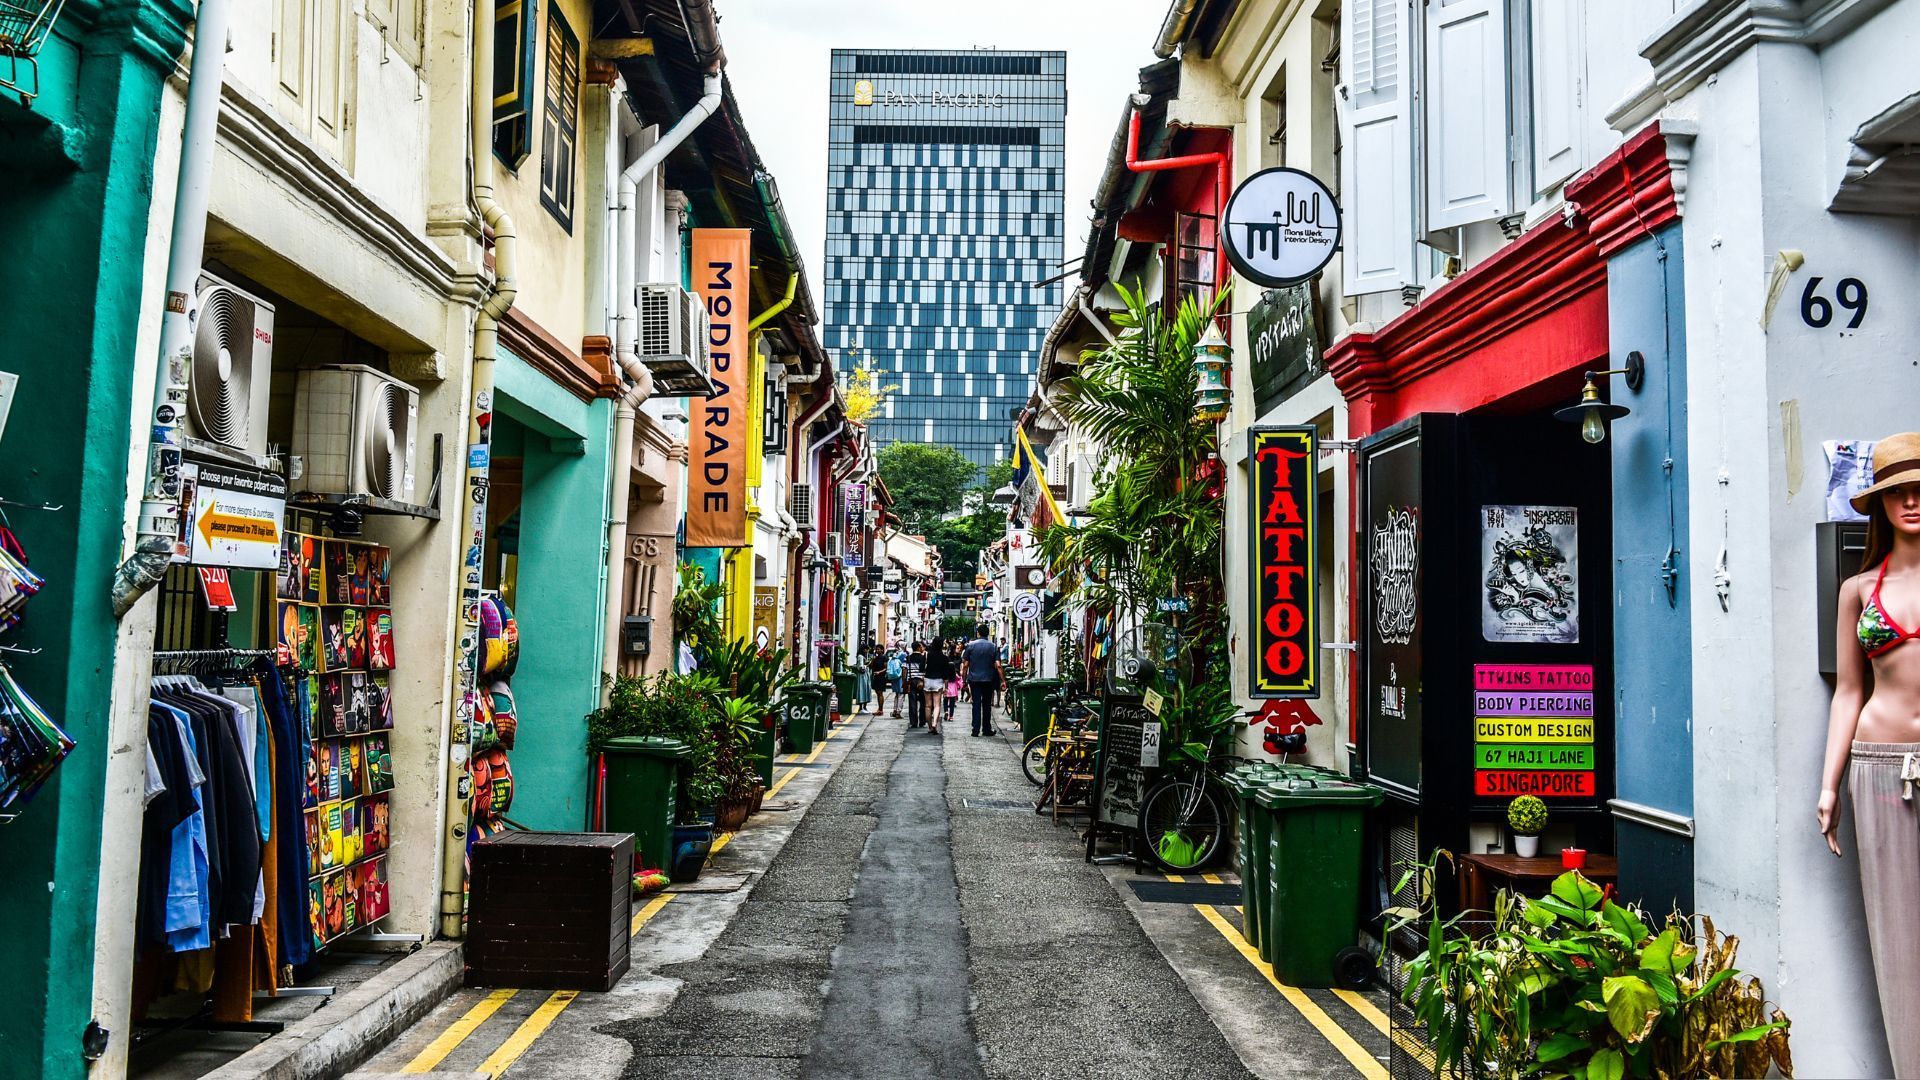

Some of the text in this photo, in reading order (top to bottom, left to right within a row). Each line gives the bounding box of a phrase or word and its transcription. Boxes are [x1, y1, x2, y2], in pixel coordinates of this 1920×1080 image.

[883, 90, 1003, 108] PAN PACIFIC
[1308, 236, 1332, 246] Design
[1800, 276, 1869, 329] 69
[255, 327, 272, 345] SHIBA
[703, 261, 733, 513] MODPARADE
[200, 469, 221, 482] choose
[221, 474, 234, 487] your
[233, 475, 254, 489] favorite
[270, 483, 285, 494] canvas
[215, 501, 224, 511] For
[224, 504, 237, 514] more
[236, 504, 253, 516] designs
[256, 508, 275, 519] purchase
[1523, 510, 1571, 519] SINGAPORE
[210, 520, 227, 533] please
[226, 522, 245, 535] proceed
[245, 523, 251, 531] to
[265, 526, 274, 536] lane
[1528, 517, 1544, 525] INK
[1546, 517, 1571, 525] SHOW
[632, 536, 659, 557] 68
[1256, 447, 1311, 676] TATTOO
[884, 583, 898, 591] SUP
[1478, 671, 1591, 684] TTWINS TATTOO
[1478, 697, 1591, 711] BODY PIERCING
[790, 705, 811, 720] 62
[1478, 723, 1591, 737] CUSTOM DESIGN
[1485, 750, 1585, 764] 67 HAJI LANE
[1486, 773, 1585, 793] SINGAPORE
